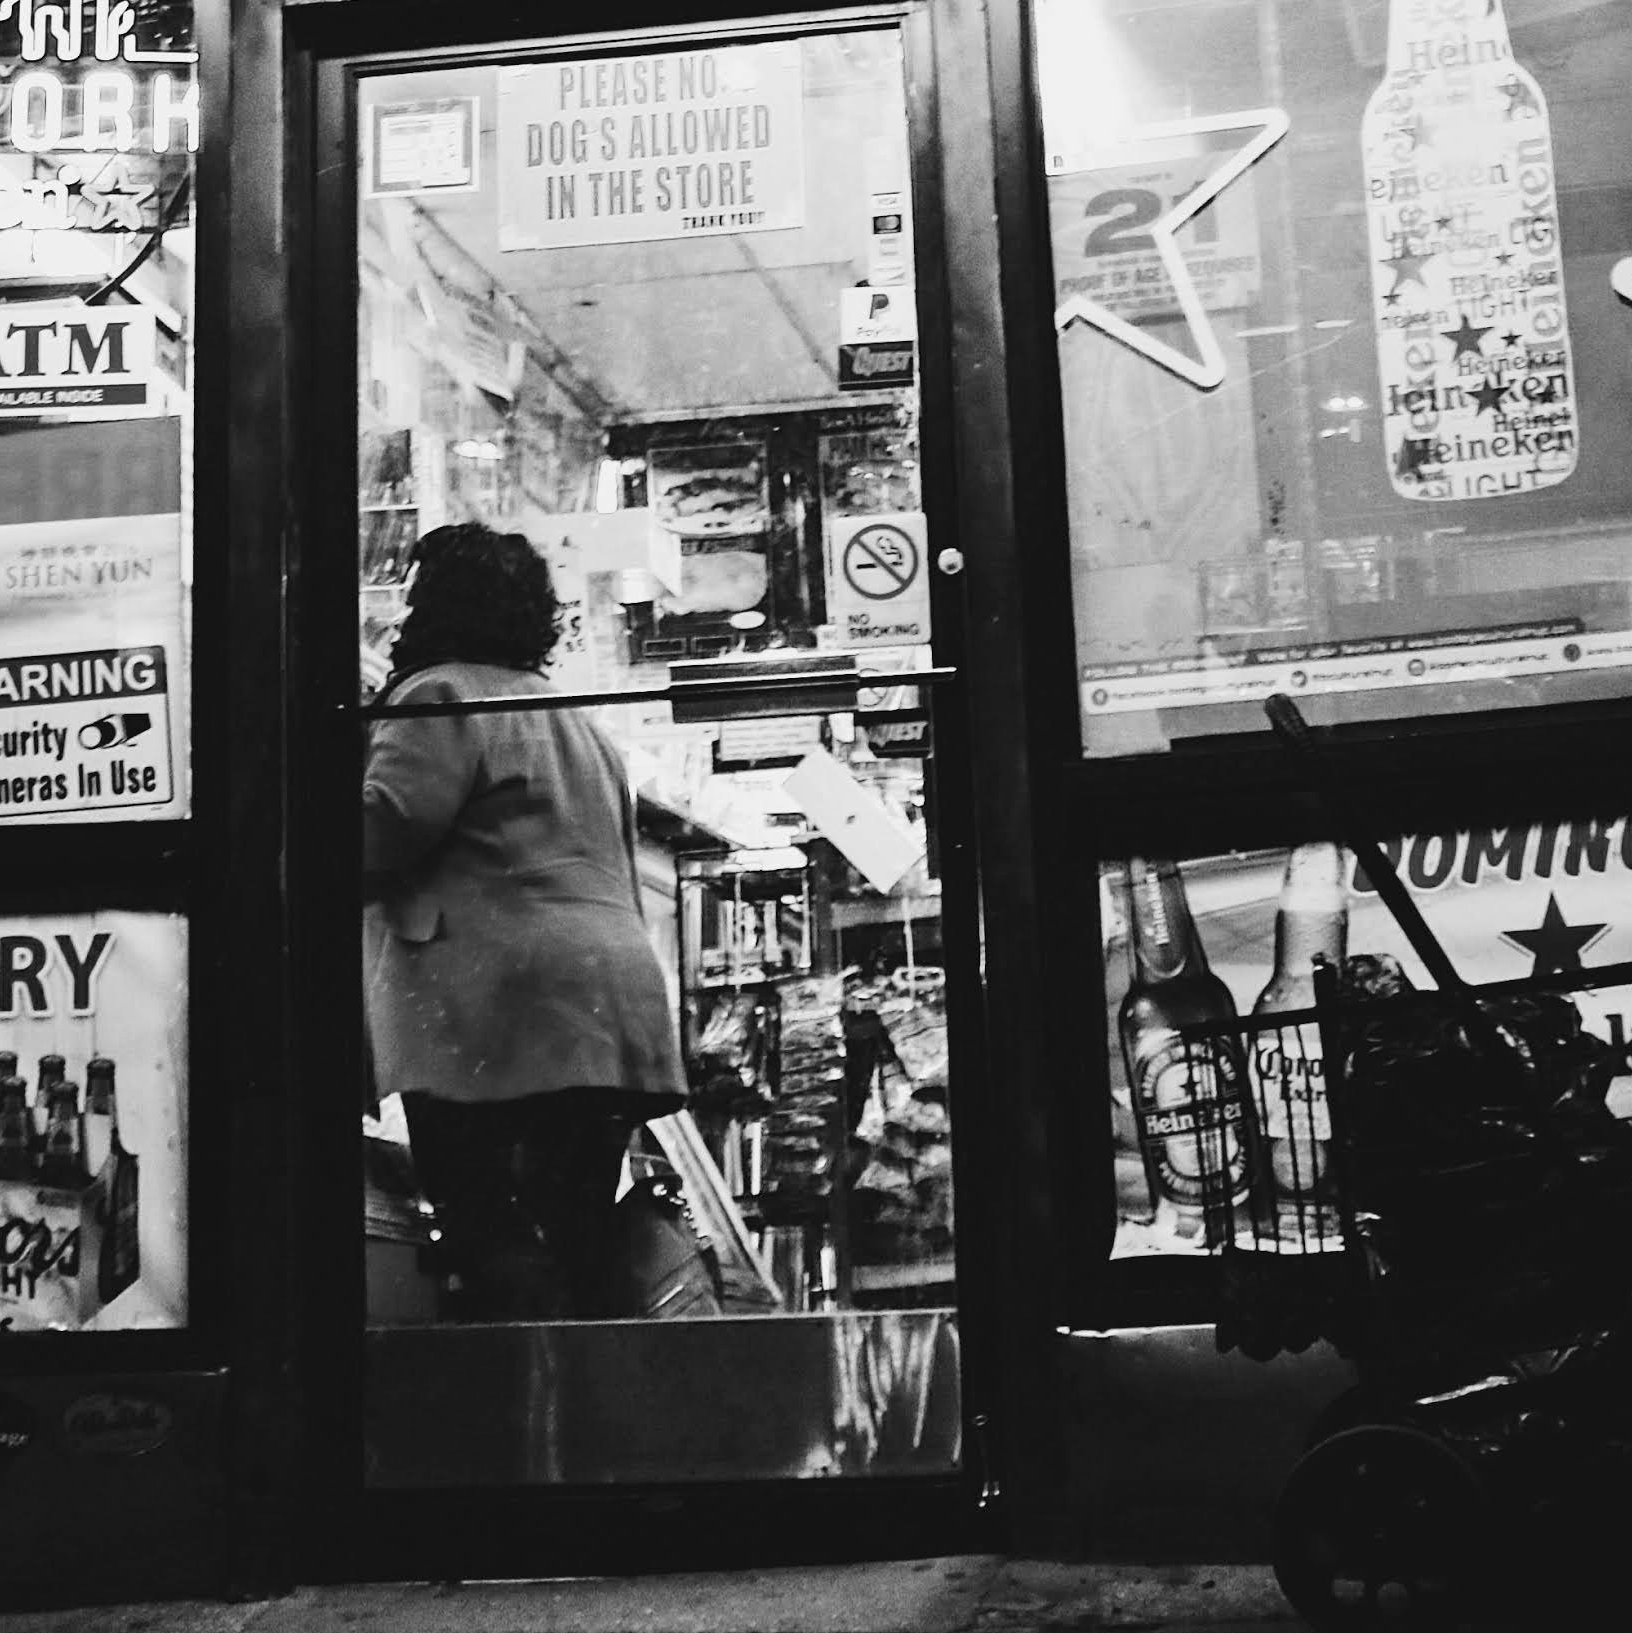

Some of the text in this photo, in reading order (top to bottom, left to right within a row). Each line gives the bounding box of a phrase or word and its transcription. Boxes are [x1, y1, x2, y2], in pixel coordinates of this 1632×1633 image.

[559, 59, 667, 111] PLEASE
[628, 104, 771, 159] ALLOWED
[545, 160, 755, 221] IN THE STORE
[6, 557, 154, 590] SHEN YUN
[848, 613, 870, 626] NO
[848, 623, 920, 640] SMOKING
[77, 771, 103, 797] In
[110, 761, 157, 795] Use
